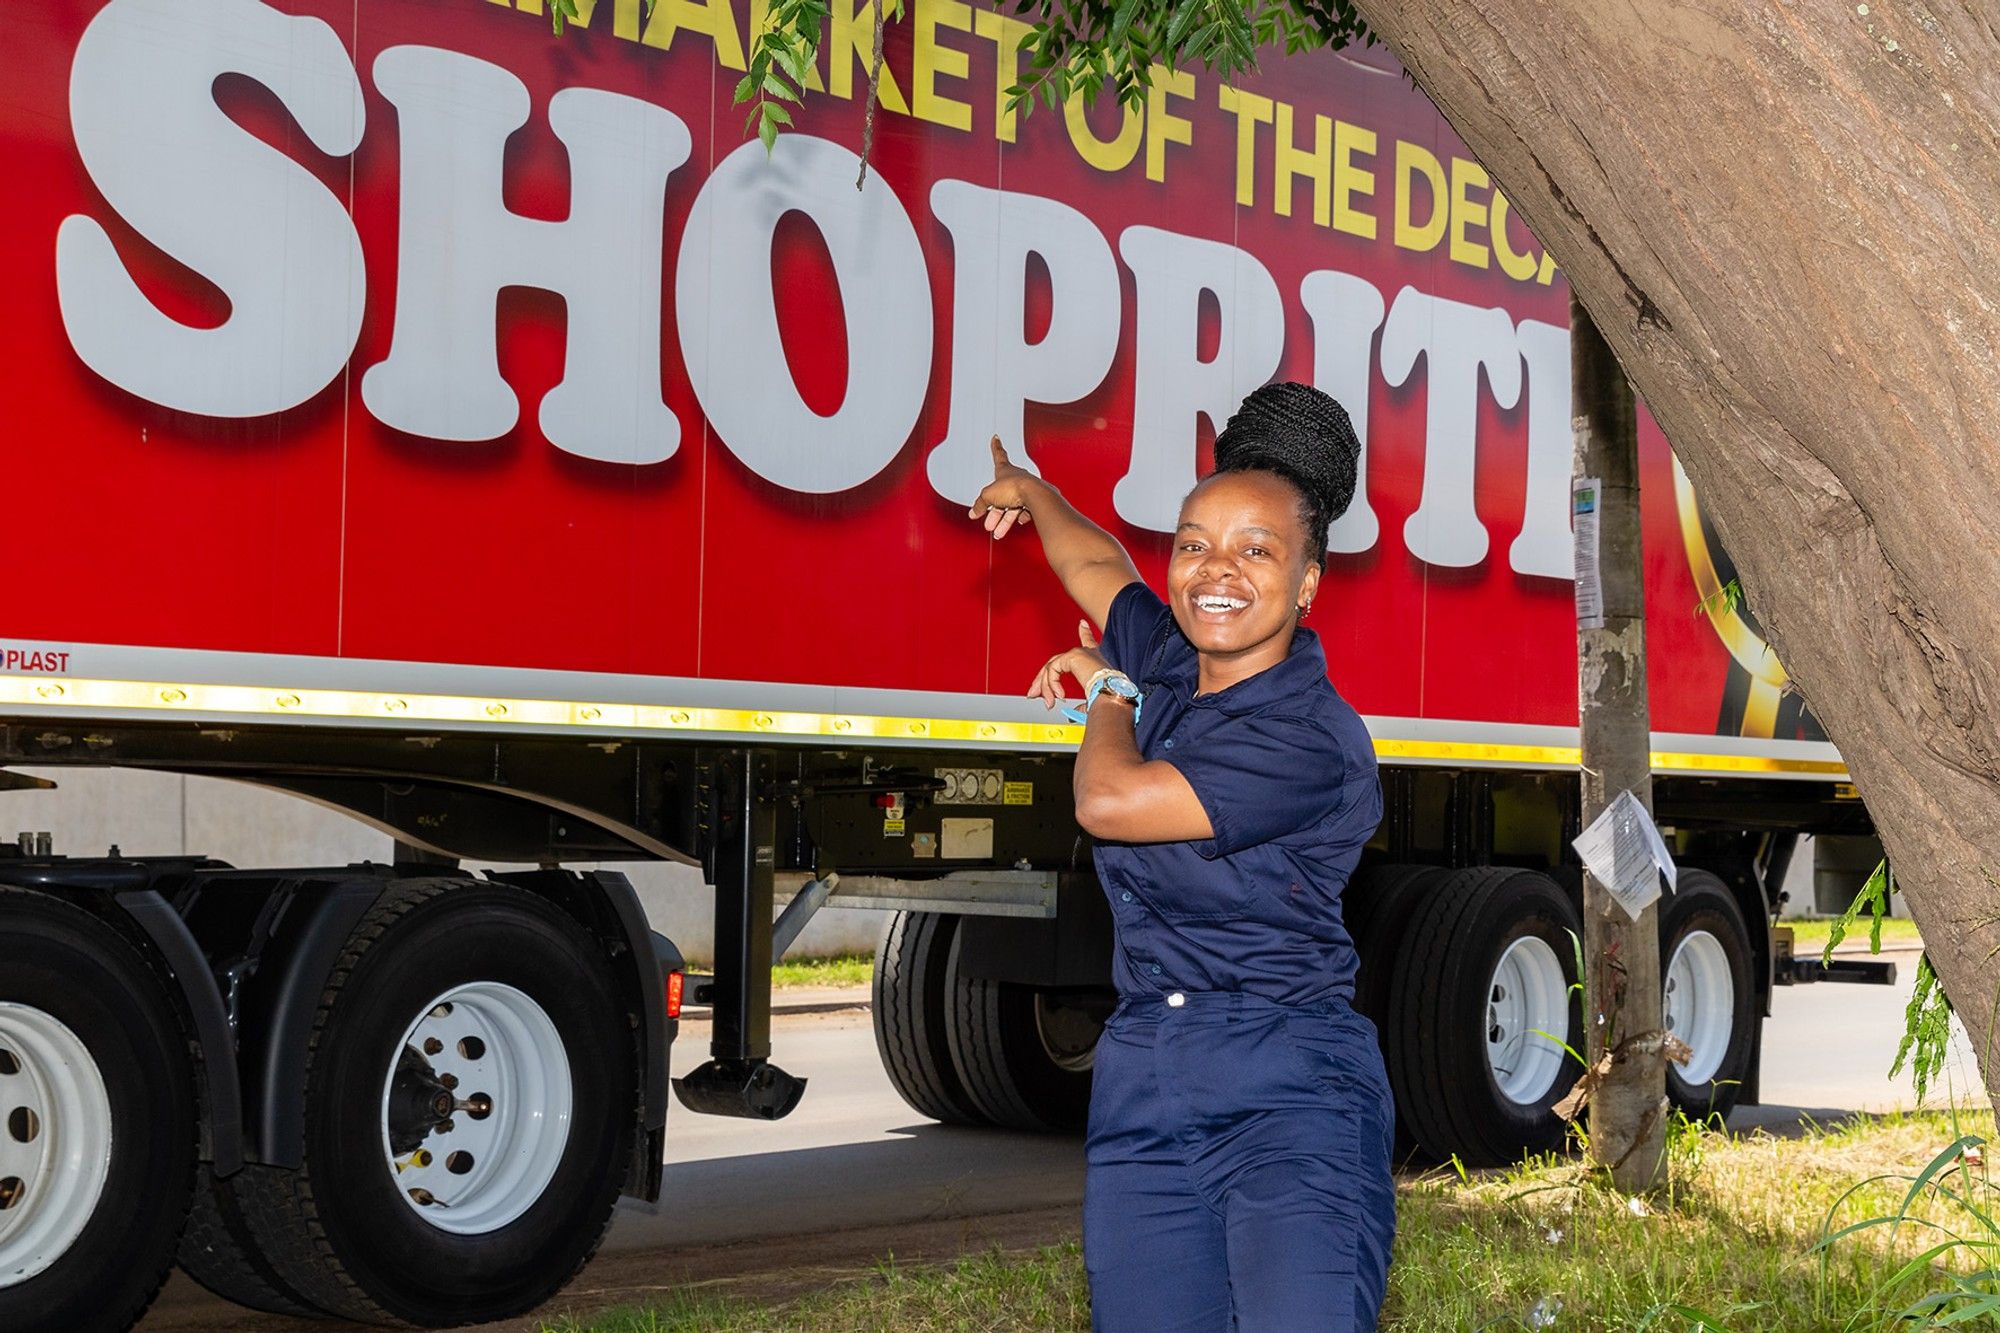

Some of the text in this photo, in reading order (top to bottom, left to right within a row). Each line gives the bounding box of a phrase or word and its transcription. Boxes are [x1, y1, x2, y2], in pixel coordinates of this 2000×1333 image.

[1063, 47, 1196, 183] OF
[1219, 83, 1378, 240] THE
[1394, 139, 1559, 286] DEC
[0, 648, 70, 672] PLAST
